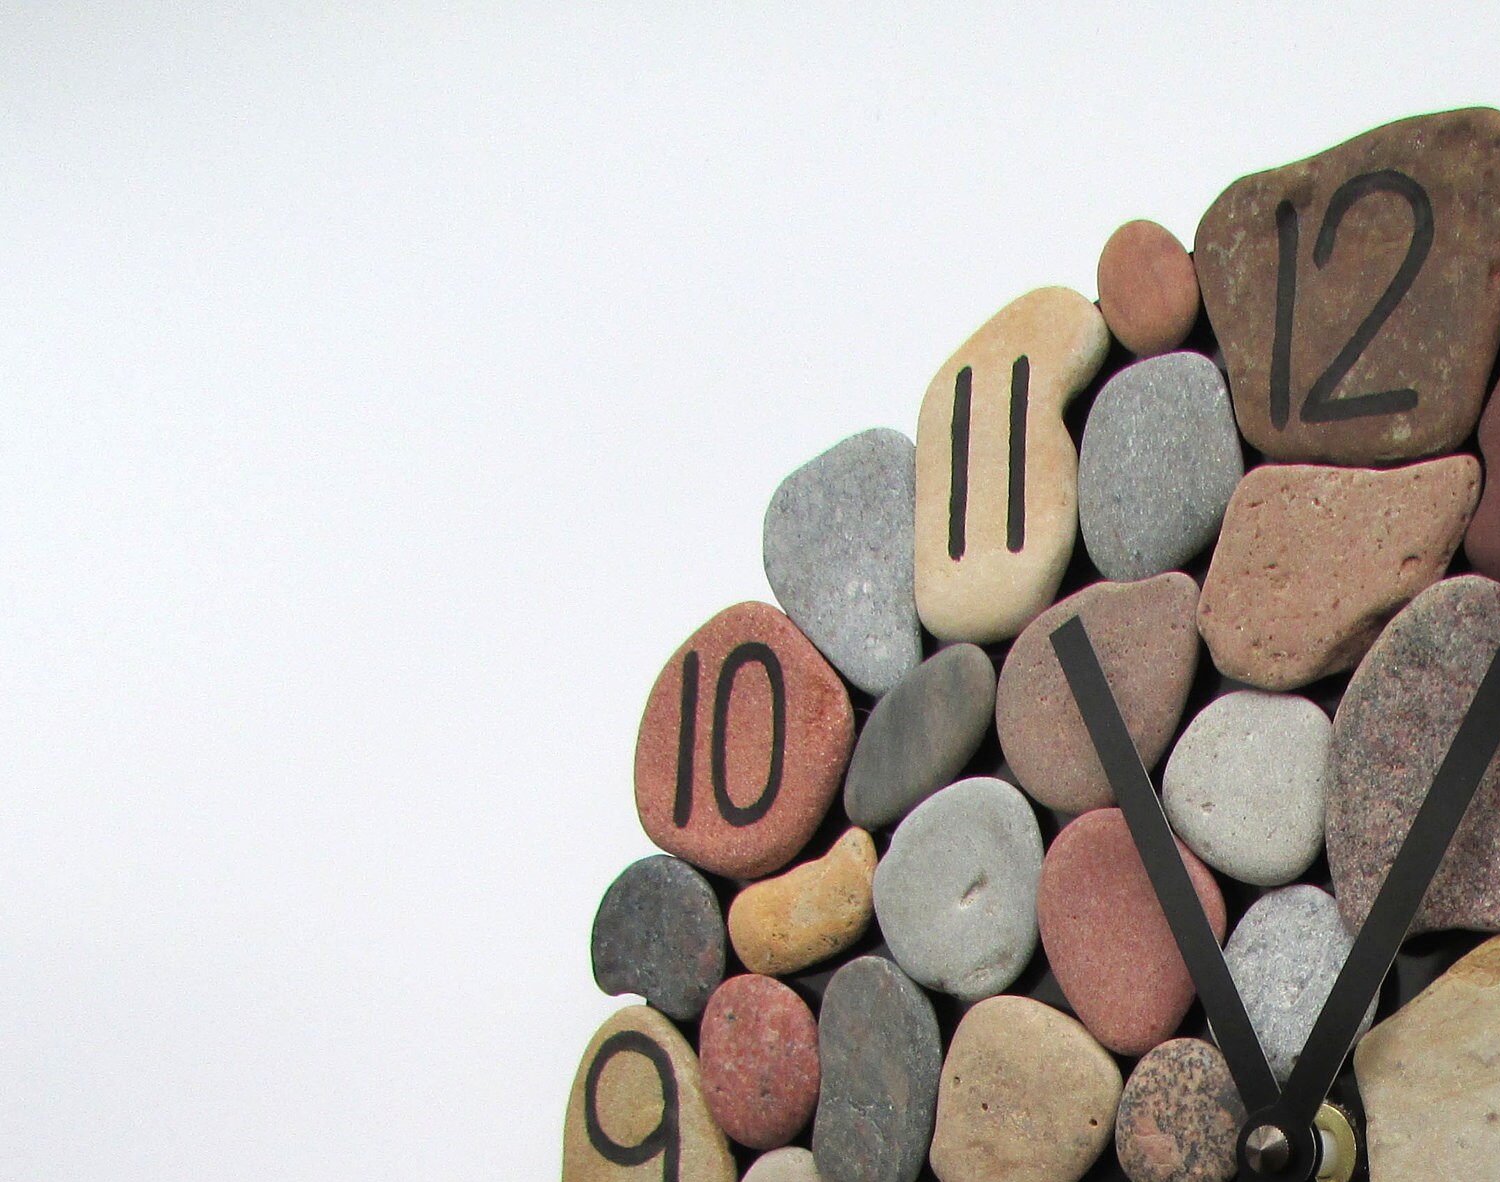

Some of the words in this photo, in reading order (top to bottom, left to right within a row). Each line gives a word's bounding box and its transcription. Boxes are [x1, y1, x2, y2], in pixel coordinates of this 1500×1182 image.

[1270, 171, 1434, 427] 12
[949, 356, 1029, 559] 11
[674, 642, 785, 827] 10
